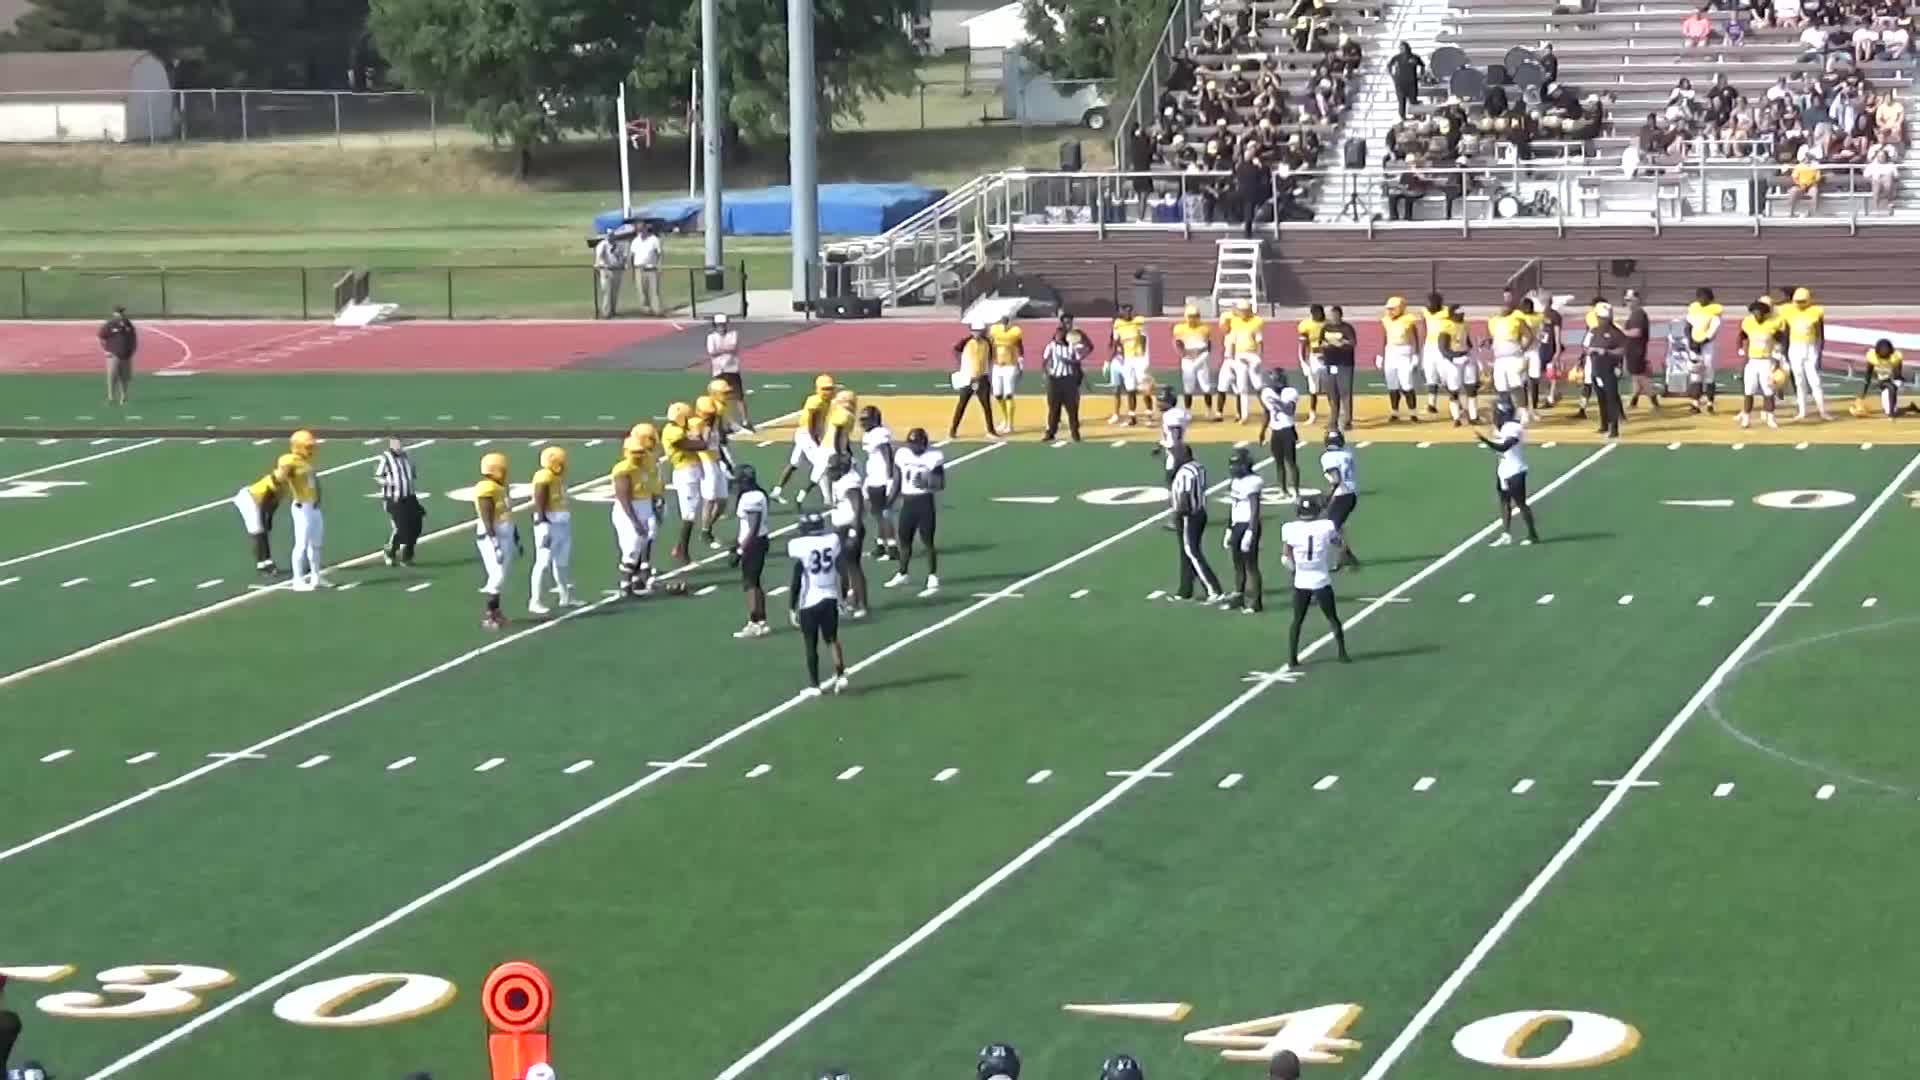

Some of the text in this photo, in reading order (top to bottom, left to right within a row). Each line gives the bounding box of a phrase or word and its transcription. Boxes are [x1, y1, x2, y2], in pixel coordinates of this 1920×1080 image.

[810, 547, 834, 574] 35
[1306, 534, 1314, 561] 1
[36, 965, 457, 1027] 30
[1183, 1002, 1642, 1068] 40
